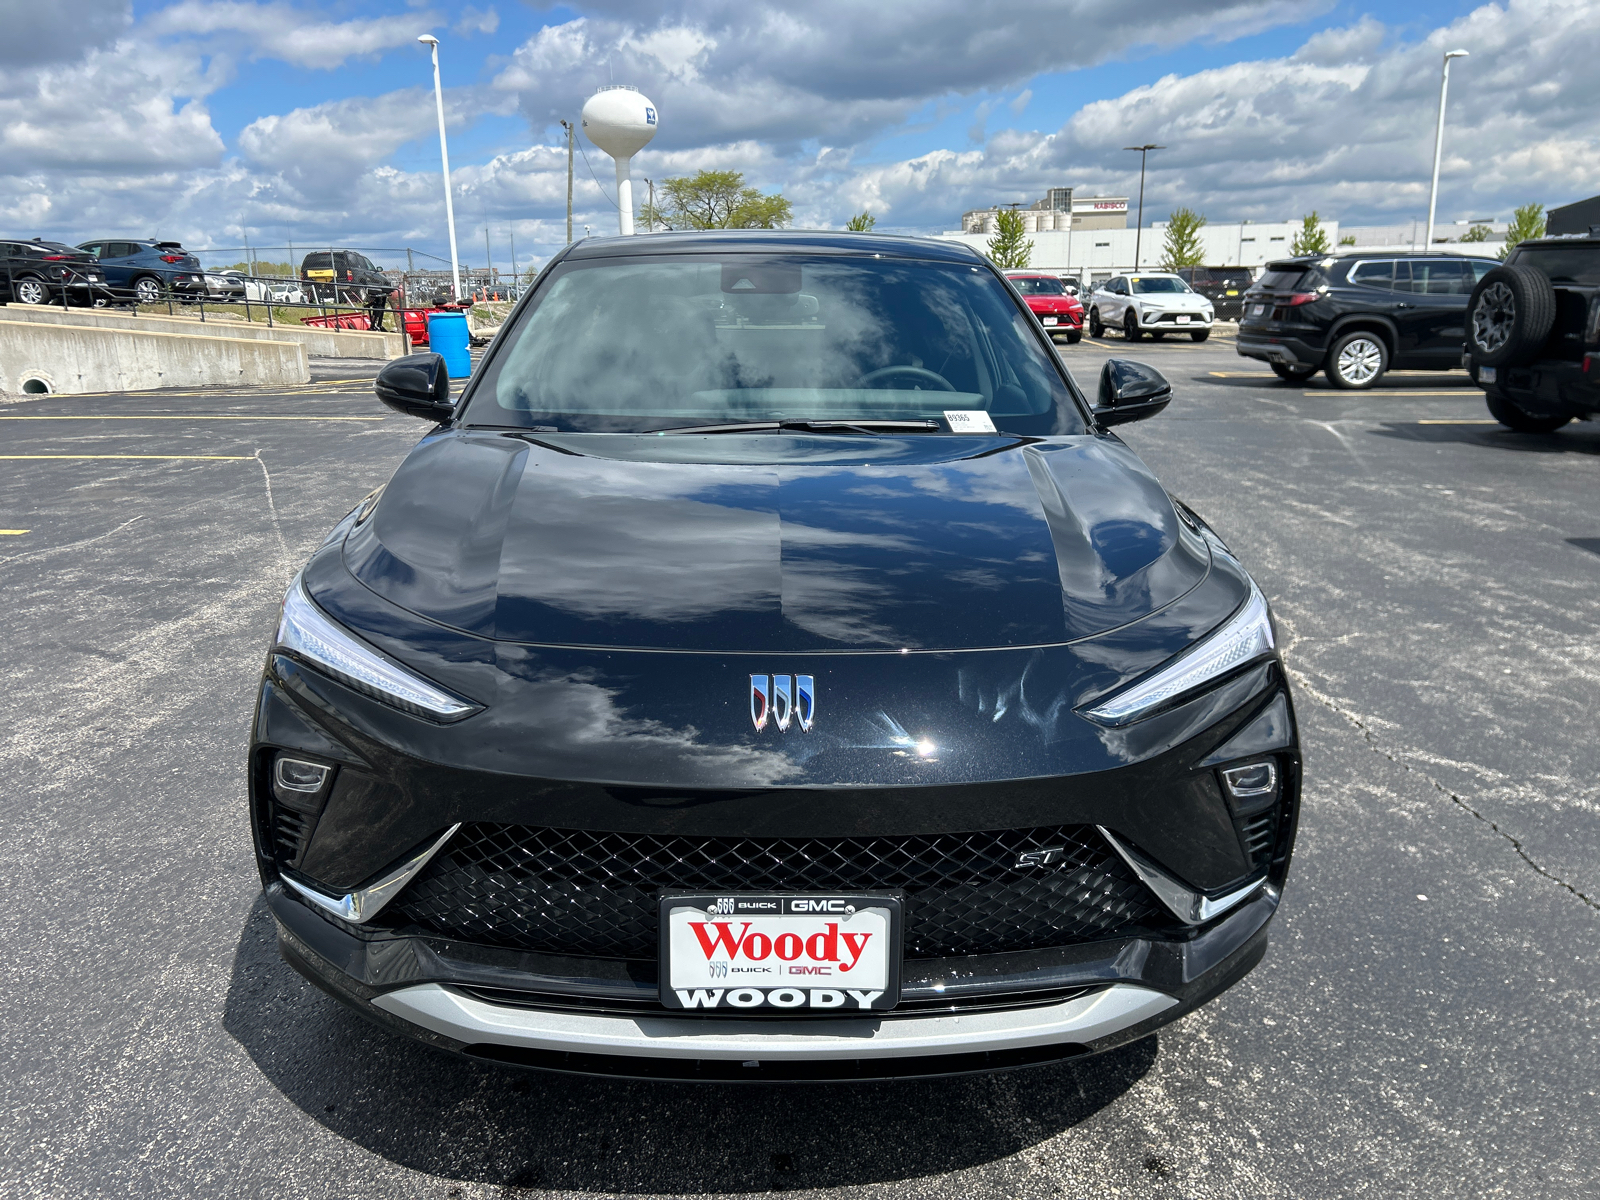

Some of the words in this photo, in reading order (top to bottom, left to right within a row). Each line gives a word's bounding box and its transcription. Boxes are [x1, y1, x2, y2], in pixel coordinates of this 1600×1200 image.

[1015, 848, 1063, 868] ST
[738, 902, 777, 910] BUICK
[791, 900, 845, 912] GMC
[687, 922, 873, 972] Woody
[788, 966, 832, 976] GMC
[675, 988, 884, 1009] WOODY
